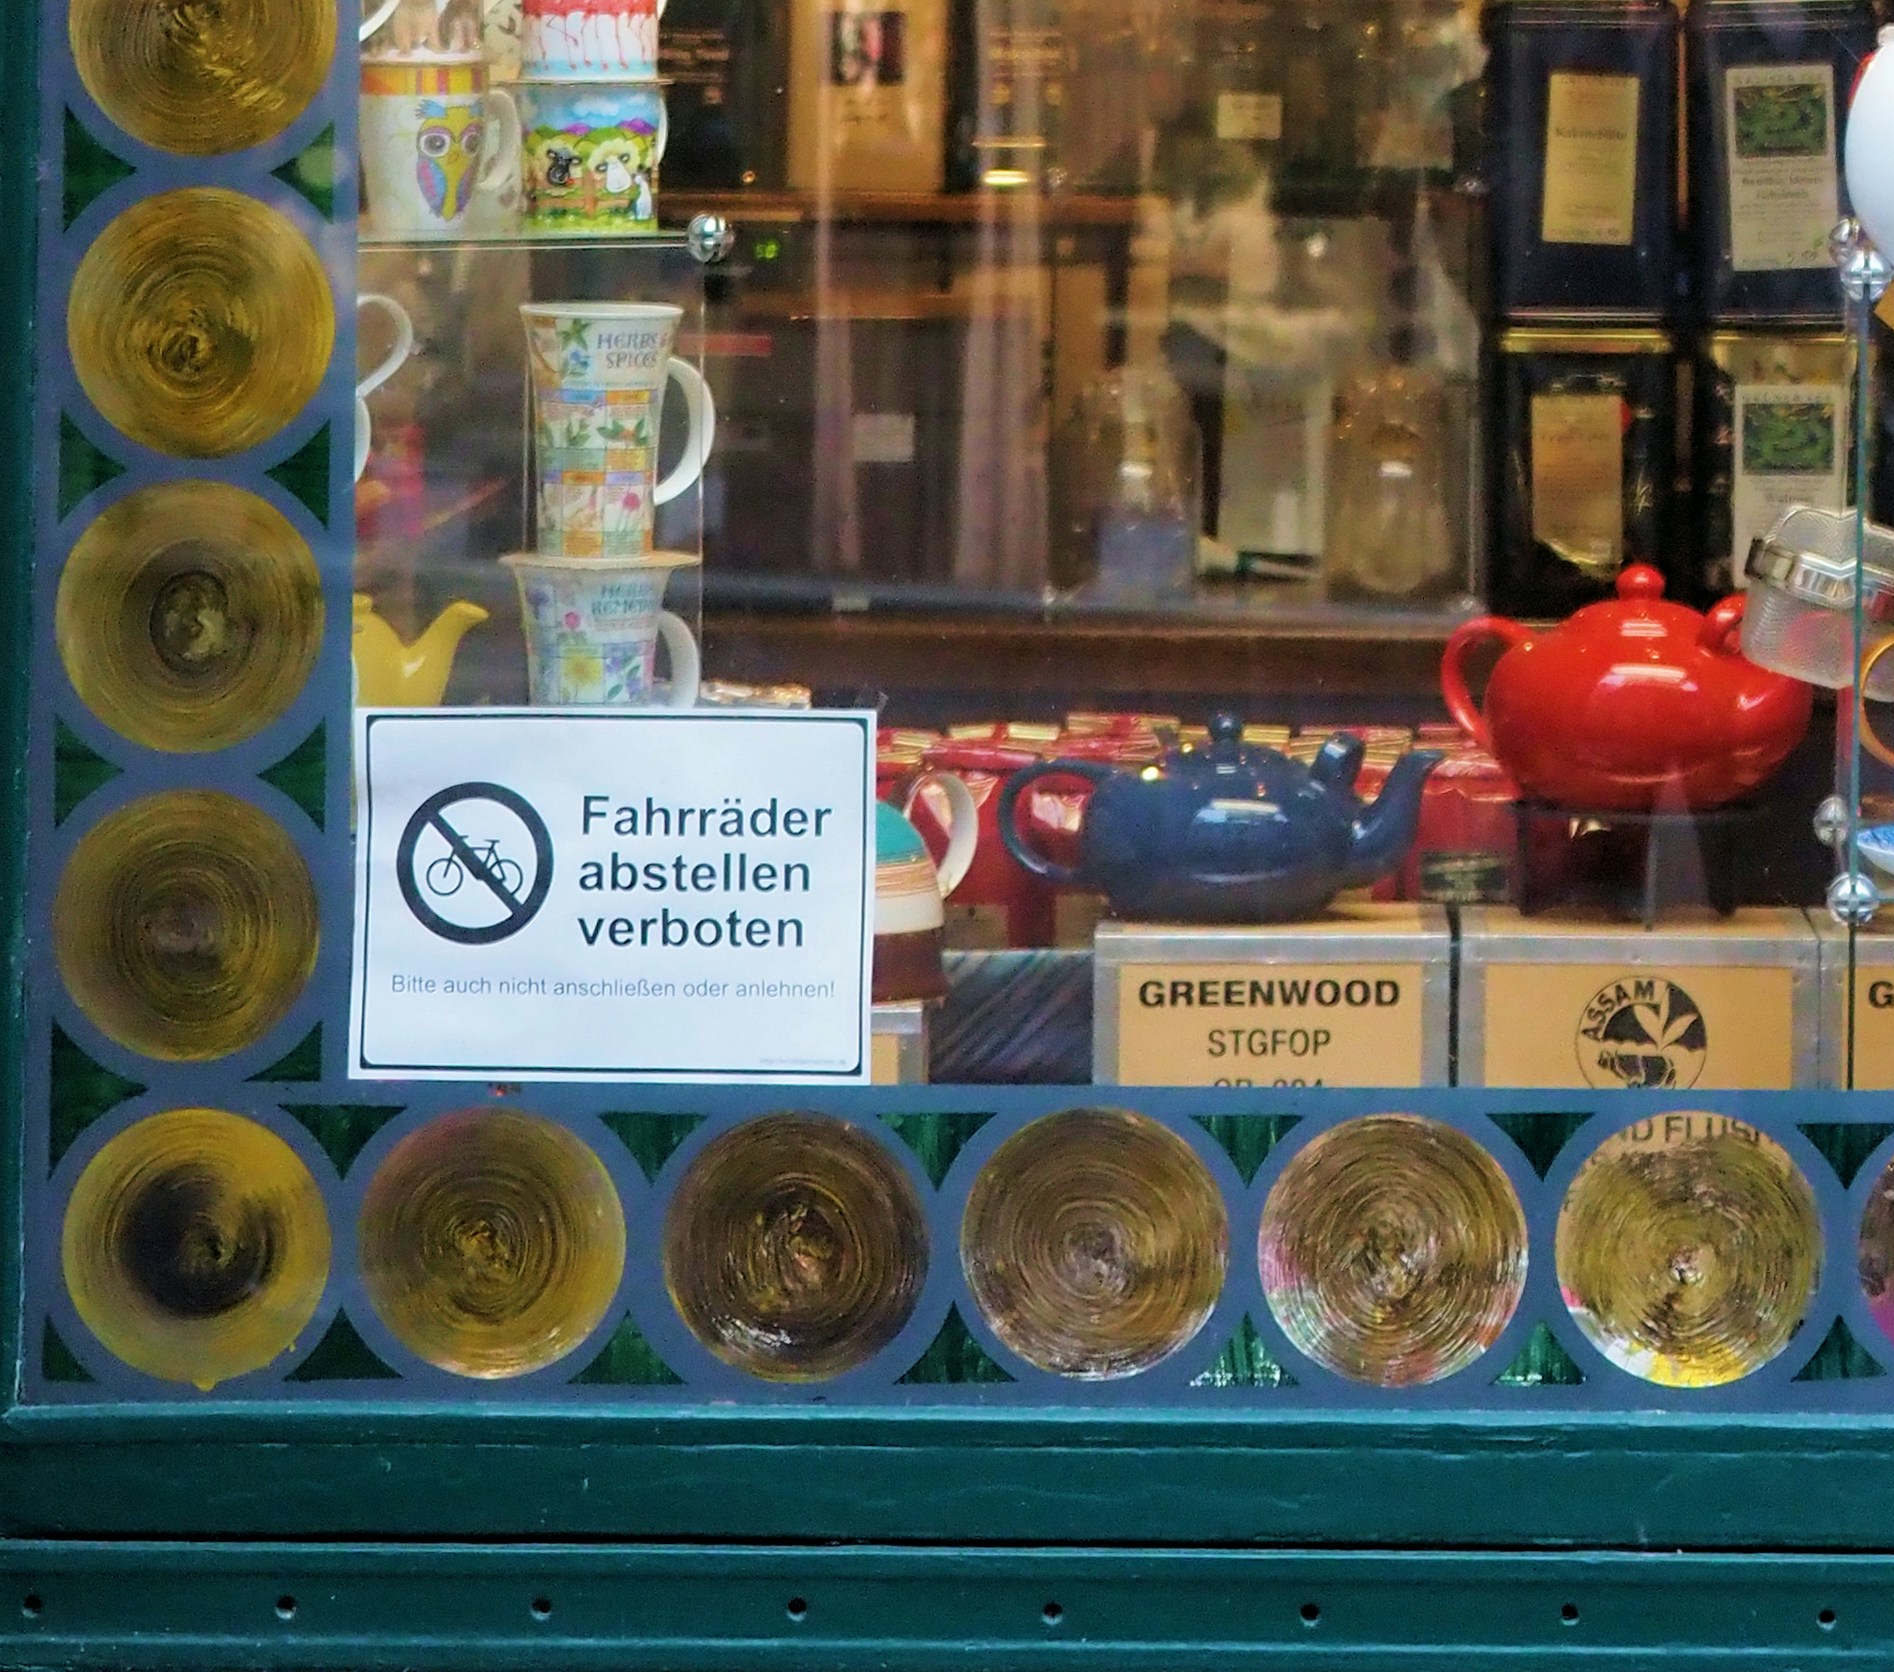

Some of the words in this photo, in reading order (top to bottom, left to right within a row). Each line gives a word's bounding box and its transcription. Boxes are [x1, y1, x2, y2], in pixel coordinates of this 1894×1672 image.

[581, 794, 832, 838] Fahrräder
[579, 852, 811, 893] abstellen
[578, 908, 802, 948] verboten
[391, 974, 436, 994] Bitte
[443, 977, 491, 995] auch
[499, 977, 547, 995] nicht
[553, 978, 676, 997] anschließen
[683, 979, 730, 997] oder
[735, 980, 835, 998] anlehnen!
[1138, 979, 1401, 1007] GREENWOOD
[1581, 979, 1655, 1042] ASSAM
[1206, 1029, 1332, 1057] STGFOP
